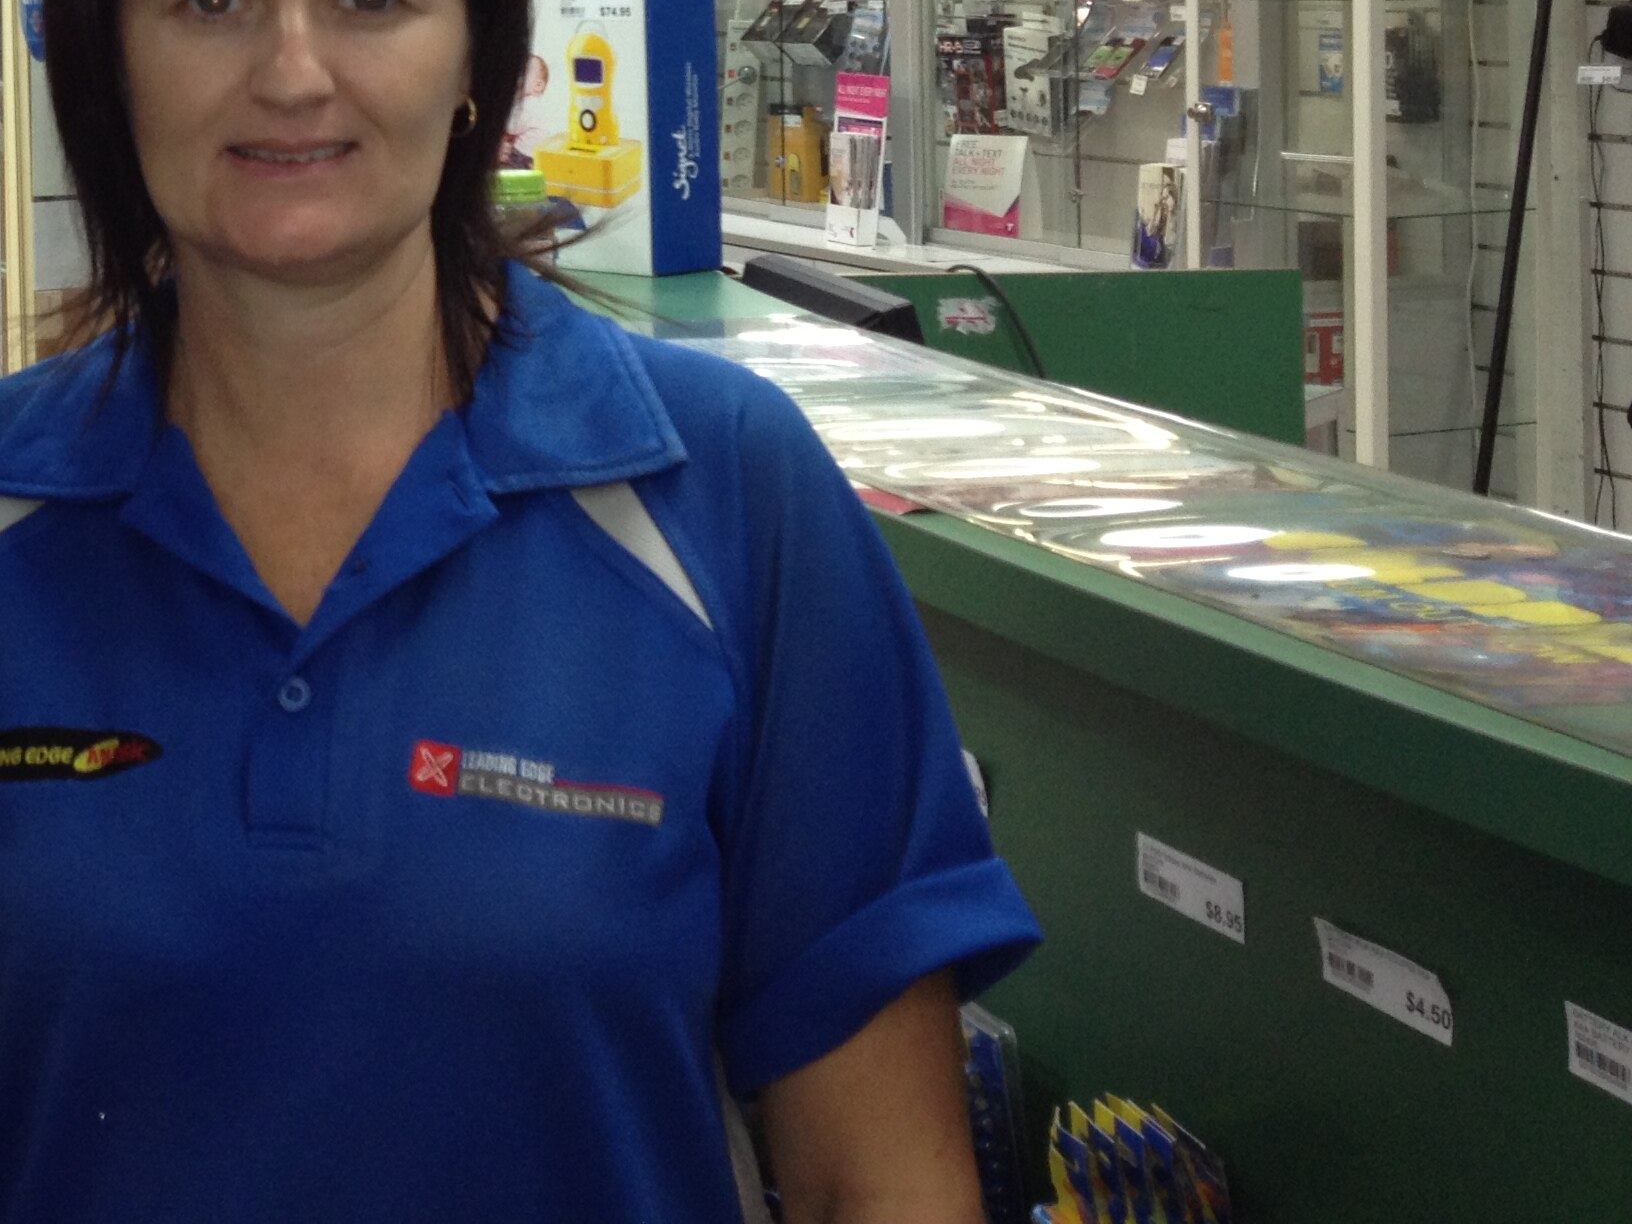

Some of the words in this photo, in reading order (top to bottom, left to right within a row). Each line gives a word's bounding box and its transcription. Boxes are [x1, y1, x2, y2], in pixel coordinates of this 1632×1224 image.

[24, 746, 74, 765] EDGE
[463, 750, 517, 776] LEADING
[520, 758, 555, 785] EDGE
[460, 774, 663, 823] ELECTRONICS
[1205, 899, 1243, 934] $8.95
[1405, 989, 1452, 1031] $4.50
